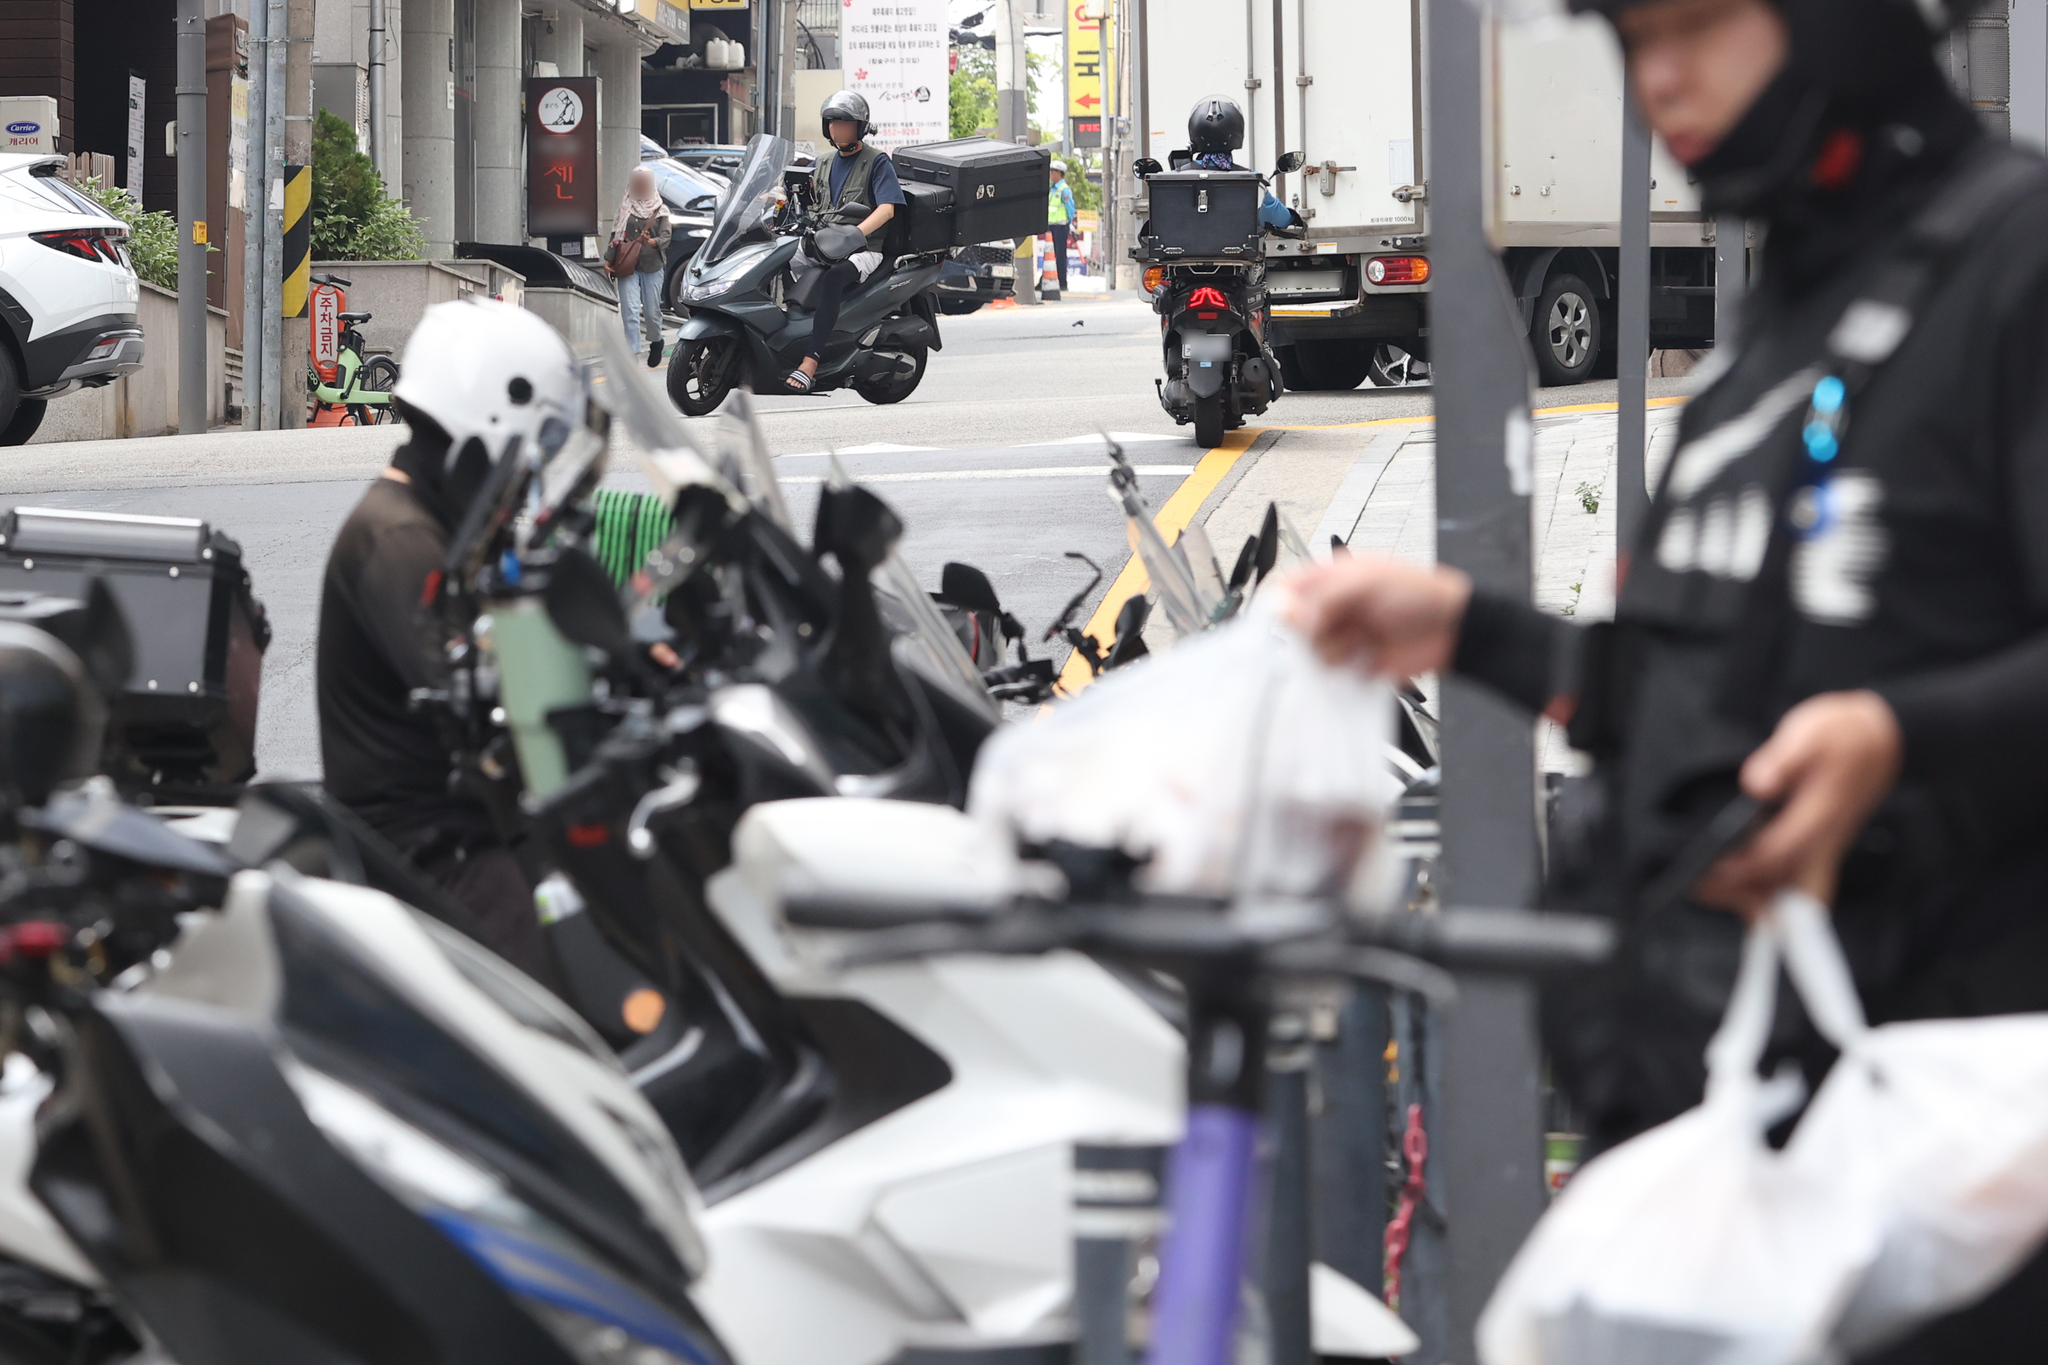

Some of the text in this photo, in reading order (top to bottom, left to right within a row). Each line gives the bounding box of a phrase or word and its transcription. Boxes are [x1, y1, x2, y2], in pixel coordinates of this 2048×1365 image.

[10, 123, 37, 132] Carrier
[8, 137, 39, 146] 캐리어
[320, 297, 333, 357] 주차금지
